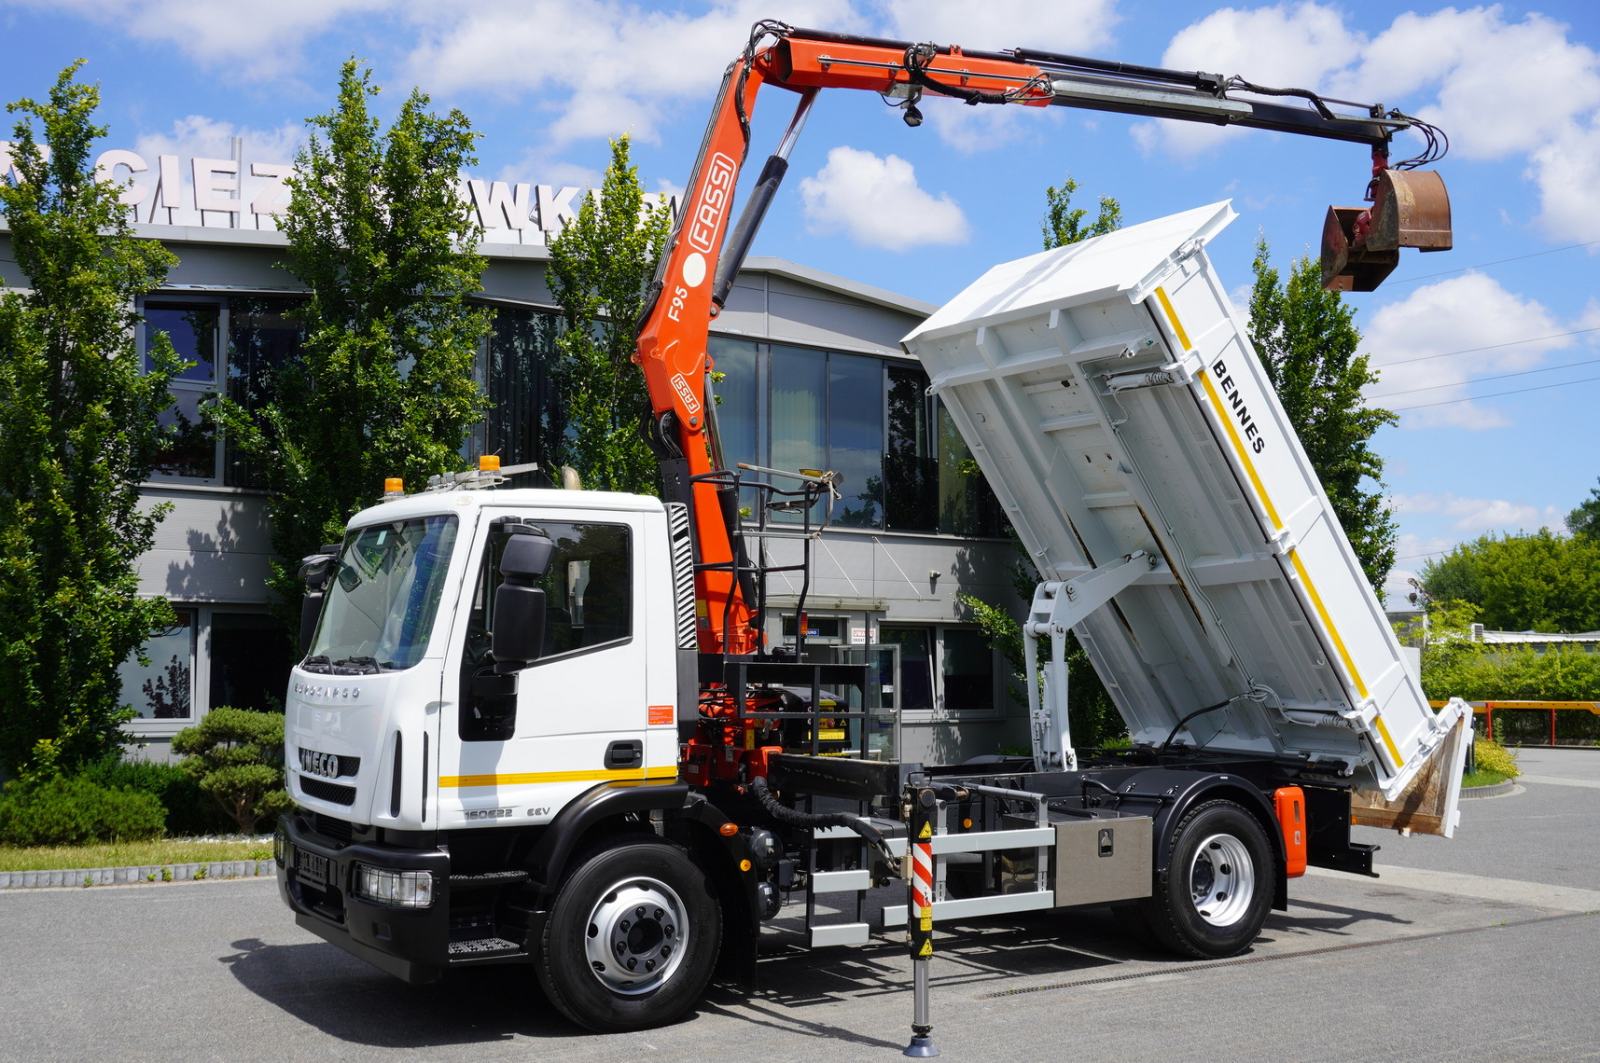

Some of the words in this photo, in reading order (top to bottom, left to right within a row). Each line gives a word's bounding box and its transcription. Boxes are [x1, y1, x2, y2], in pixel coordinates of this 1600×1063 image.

[692, 159, 734, 246] FASSI
[667, 287, 690, 322] F95
[673, 374, 700, 414] FASSI
[1212, 359, 1265, 454] BENNES
[301, 748, 339, 779] IVECO
